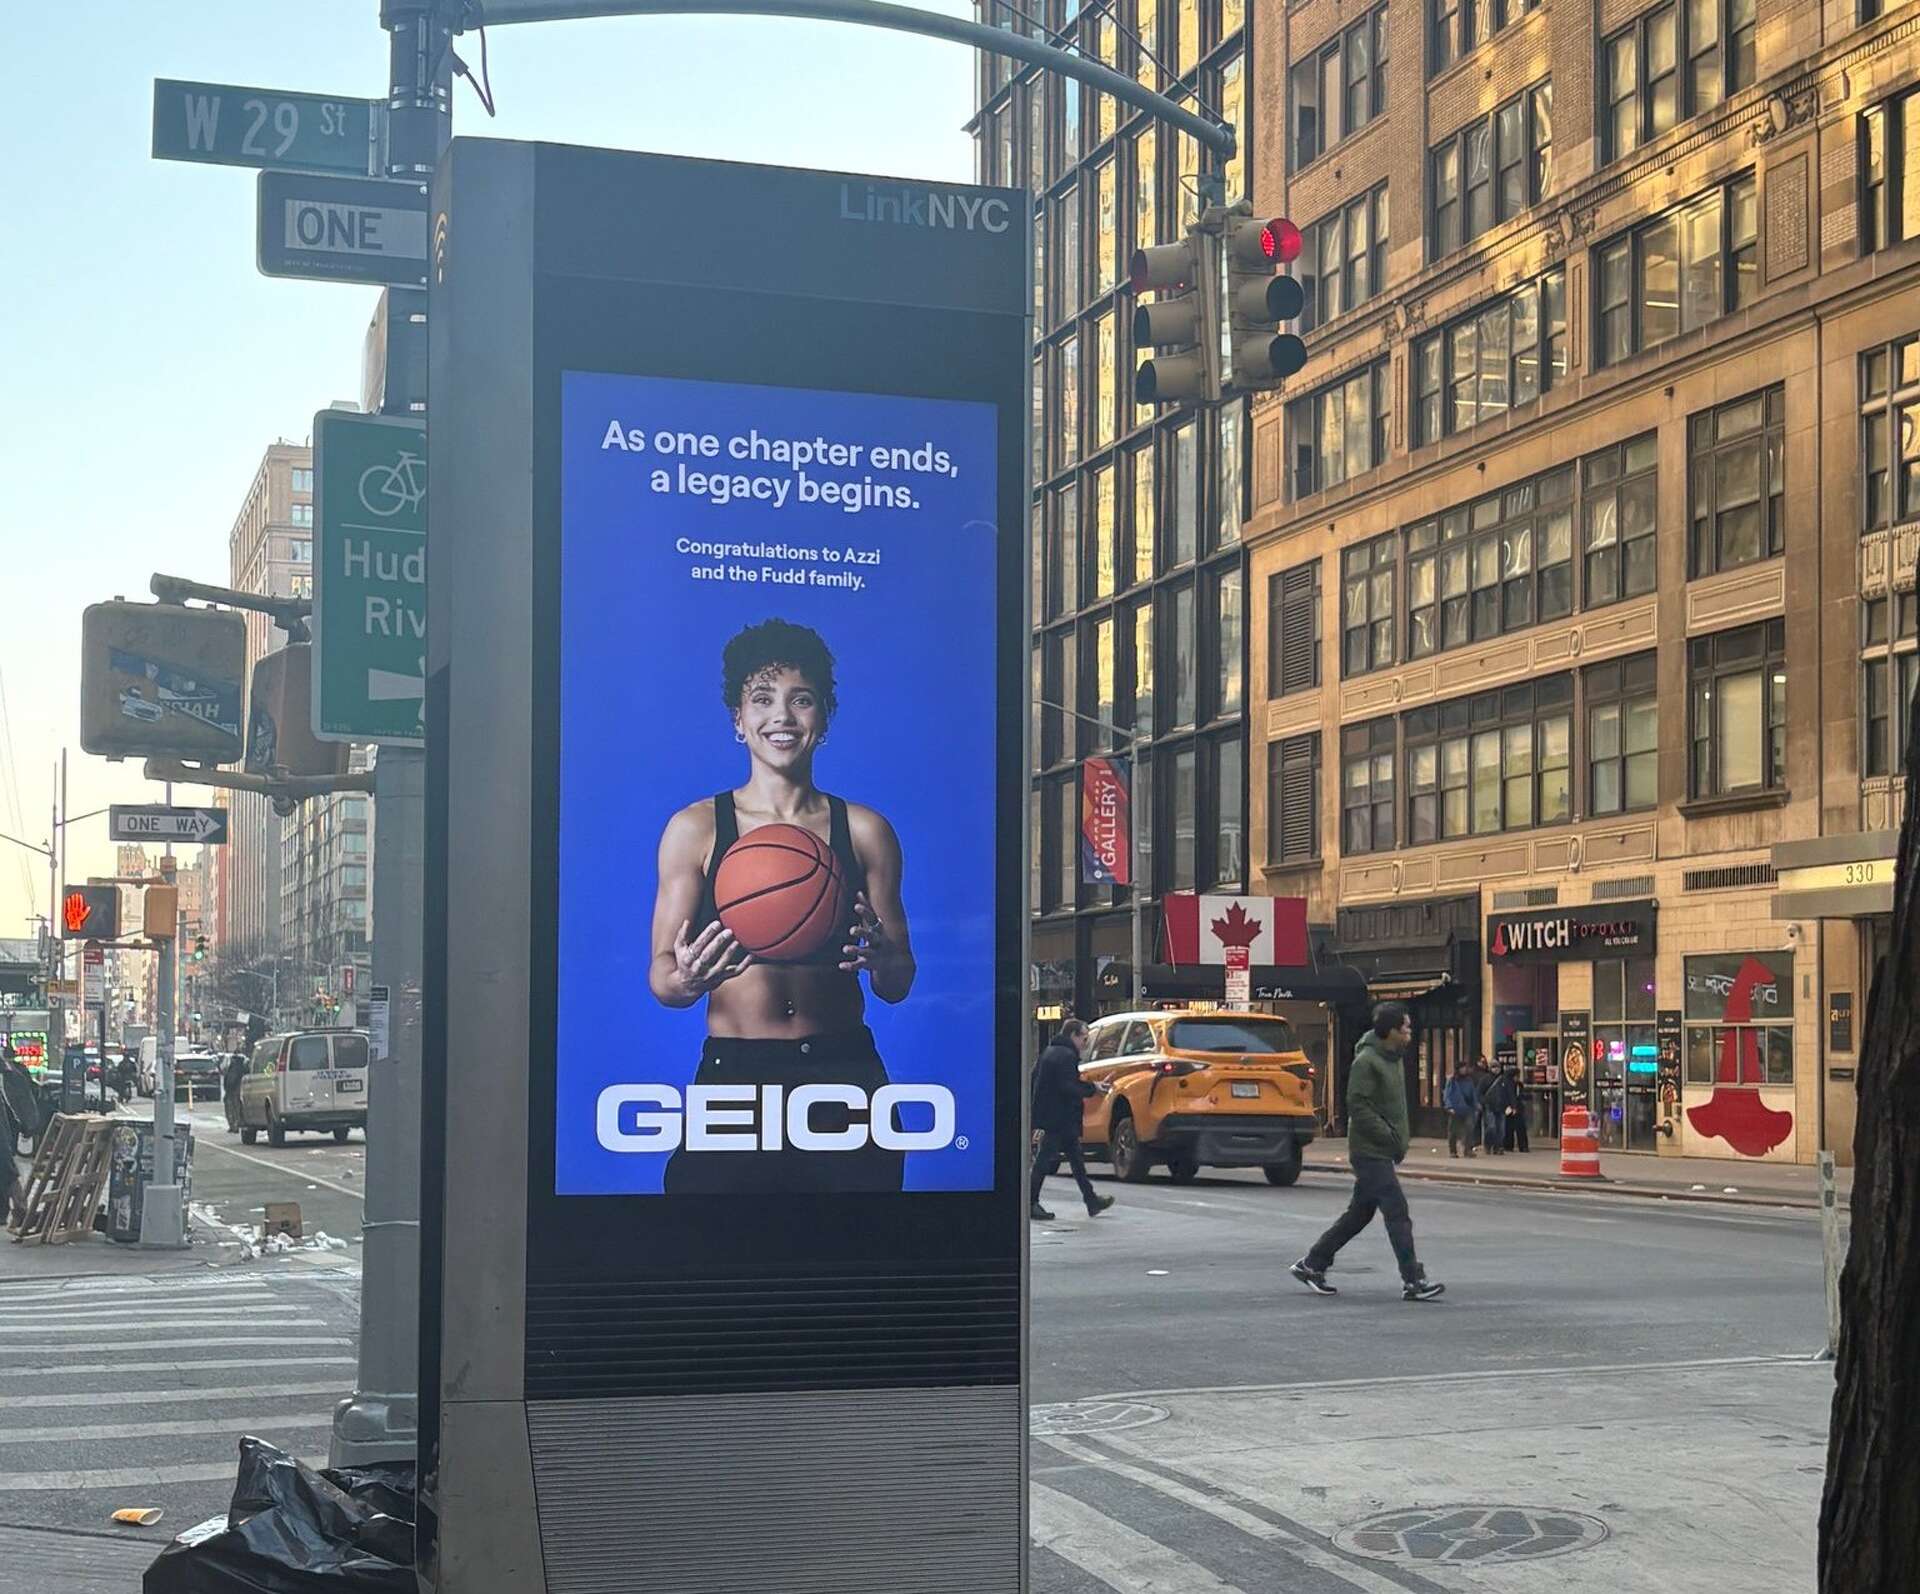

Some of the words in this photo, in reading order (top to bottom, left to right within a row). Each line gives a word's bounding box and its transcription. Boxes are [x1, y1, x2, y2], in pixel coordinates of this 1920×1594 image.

[185, 94, 220, 152] W
[241, 99, 299, 158] 29
[319, 102, 346, 136] St
[297, 206, 383, 250] ONE
[840, 183, 1009, 233] LinkNYC
[601, 420, 645, 452] As
[654, 429, 720, 457] one
[728, 430, 863, 471] chapter
[870, 443, 958, 478] ends,
[650, 470, 671, 493] a
[678, 464, 791, 508] legacy
[799, 472, 920, 513] begins.
[676, 537, 819, 562] Congratulations
[822, 548, 841, 563] to
[844, 548, 881, 564] Azzi
[691, 564, 725, 581] and
[728, 566, 758, 583] the
[762, 567, 806, 586] Fudd
[809, 570, 866, 589] family.
[127, 817, 161, 832] ONE
[176, 818, 210, 833] WAY
[1100, 781, 1116, 867] GALLERY
[1846, 864, 1874, 884] 330
[1508, 919, 1570, 950] WITCH
[597, 1083, 956, 1152] GEICO
